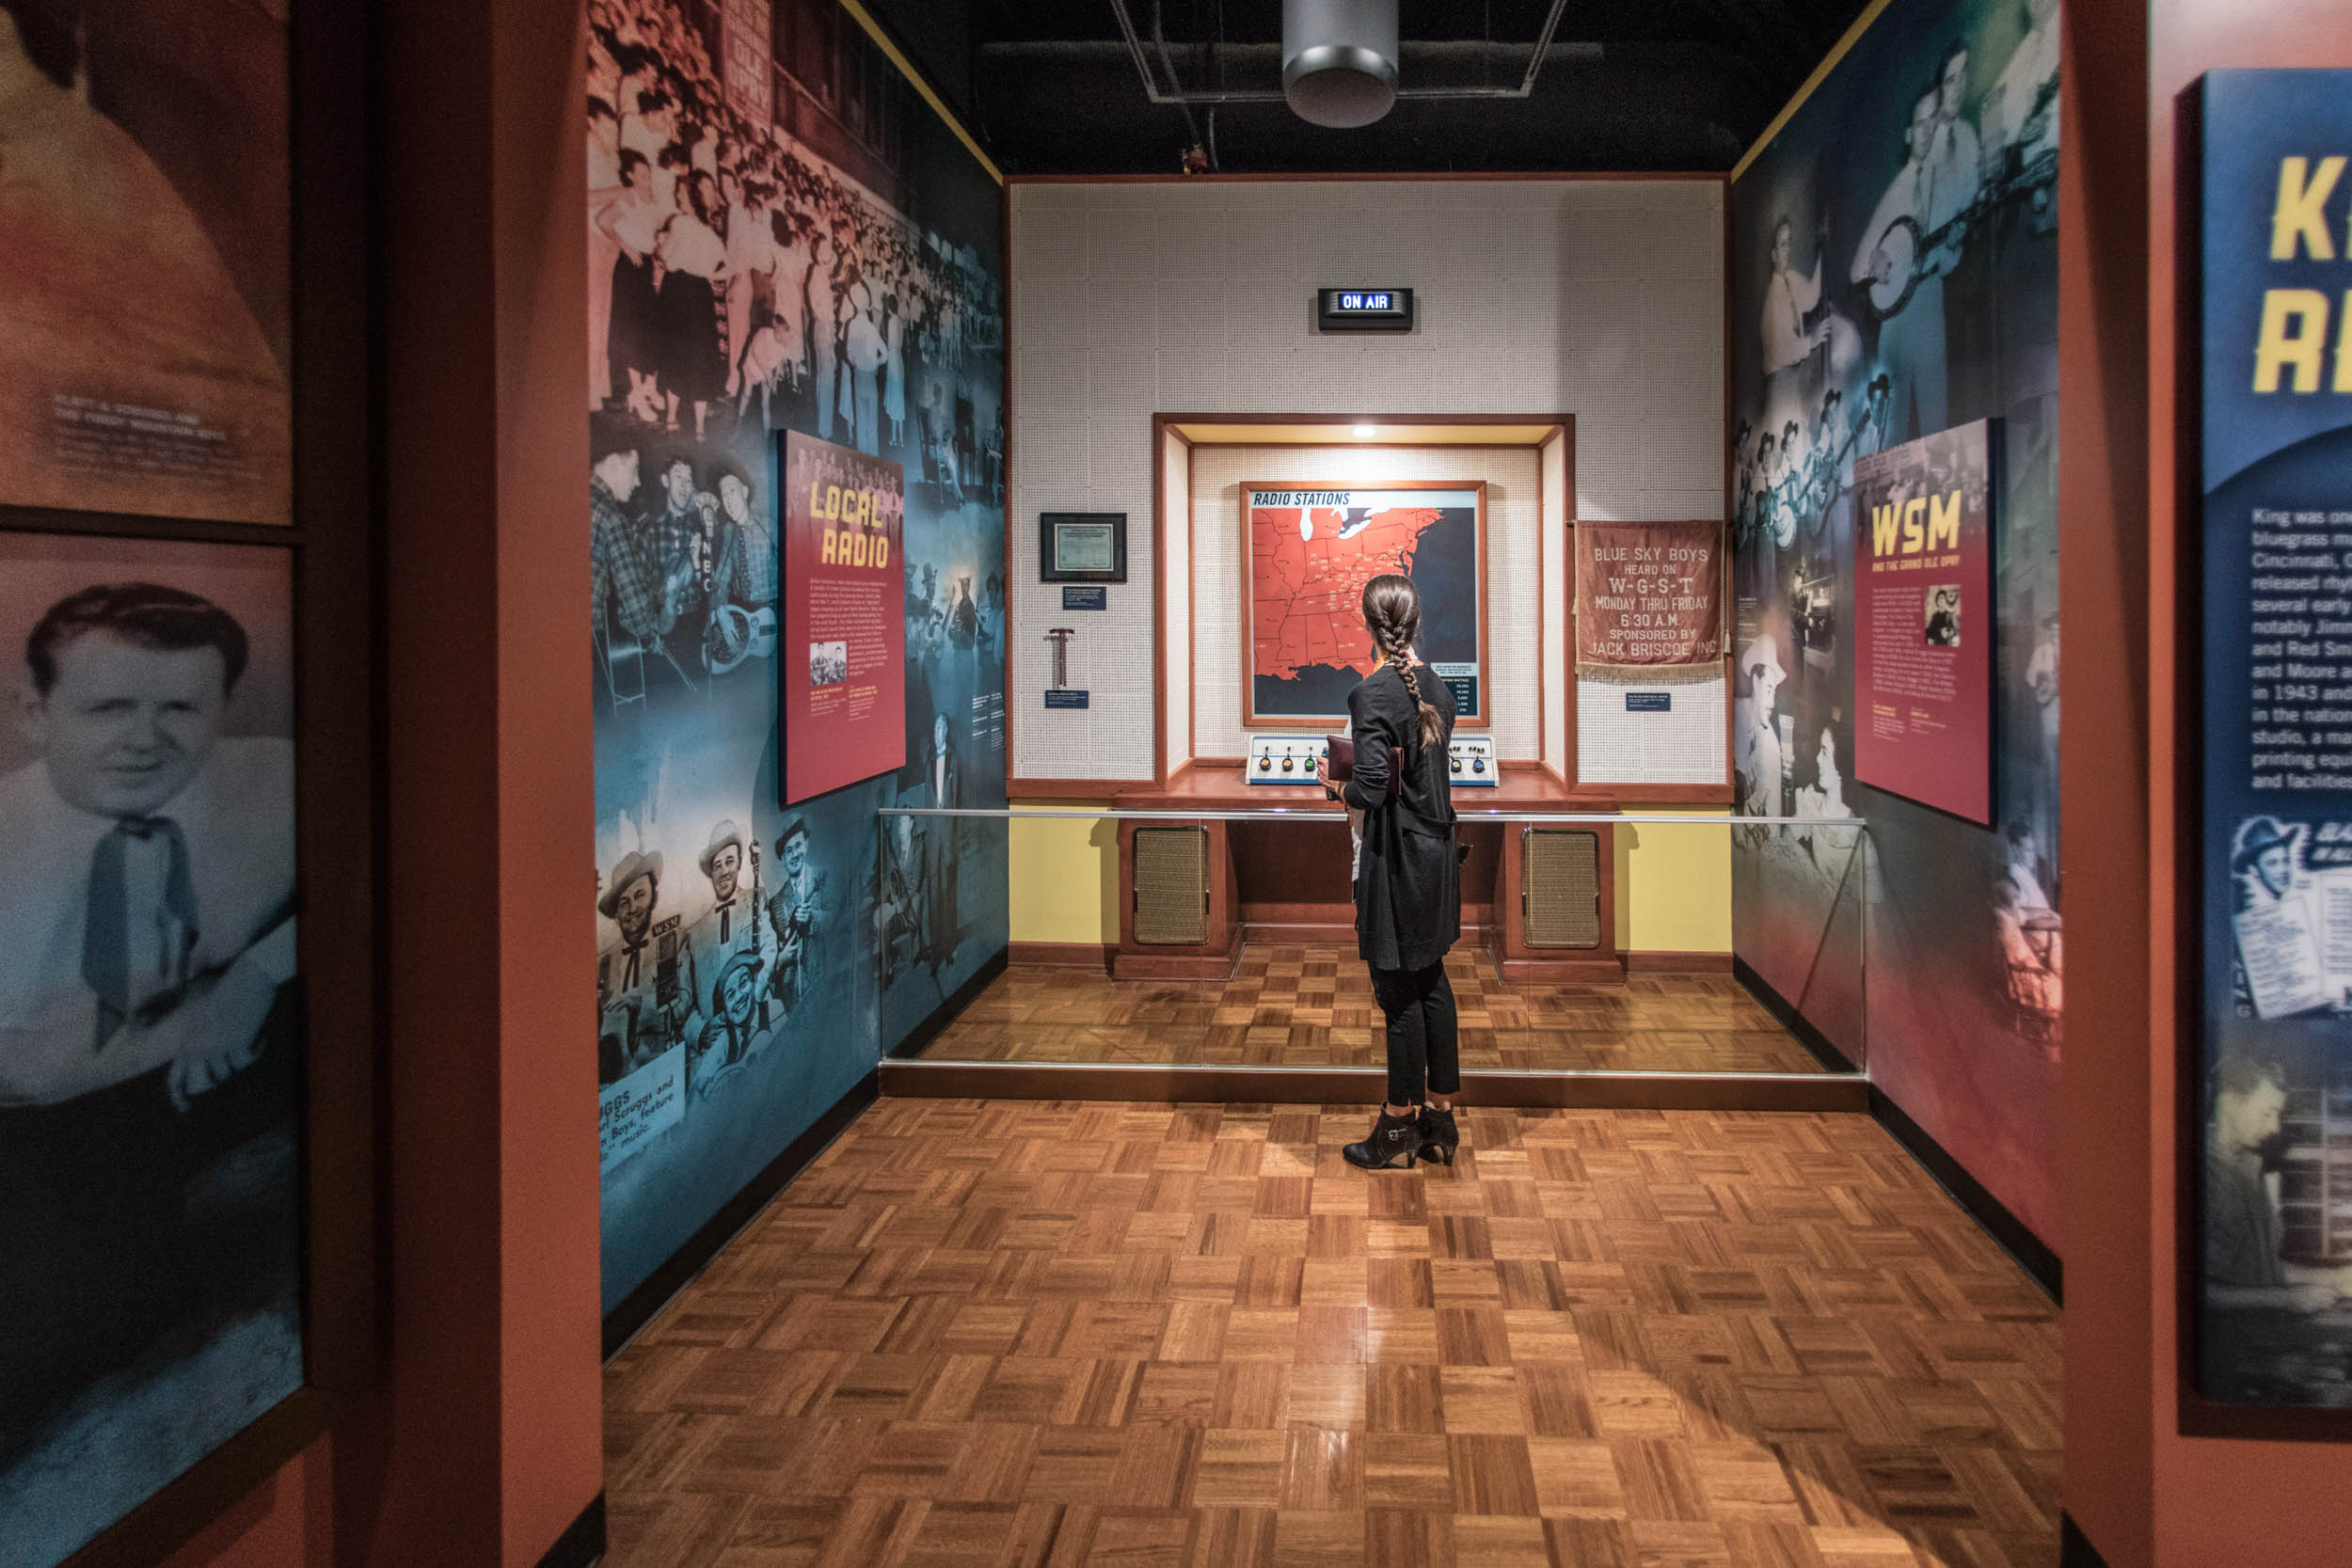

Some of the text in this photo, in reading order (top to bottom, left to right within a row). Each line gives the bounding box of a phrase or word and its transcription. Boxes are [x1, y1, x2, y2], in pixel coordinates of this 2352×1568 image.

[2269, 156, 2352, 261] K
[1343, 294, 1388, 309] ON AIR
[810, 482, 882, 528] LOCAL
[1253, 493, 1350, 505] RADIO STATIONS
[1872, 489, 1962, 557] WSM
[2251, 509, 2291, 527] King
[2295, 512, 2325, 524] was
[2251, 531, 2329, 548] bluegrass
[821, 528, 888, 569] RADIO
[1595, 547, 1708, 562] BLUE SKY BOYS
[2251, 552, 2340, 570] Cincinnati,
[1624, 564, 1677, 575] HEARD ON
[1609, 578, 1693, 594] W-G-S-T
[2251, 576, 2319, 590] released
[1595, 595, 1708, 610] MONDAY THRU FRIDAY
[2251, 598, 2351, 615] several early
[1610, 628, 1695, 640] SPONSORED BY
[2251, 620, 2312, 637] notably
[1588, 641, 1625, 656] JACK
[1630, 642, 1692, 656] BRISCOE
[2251, 641, 2282, 656] and
[2286, 641, 2319, 656] Red
[2251, 663, 2282, 678] and
[2286, 662, 2337, 678] Moore
[2251, 685, 2268, 700] in
[2274, 685, 2318, 700] 1943
[2251, 707, 2268, 721] in
[2272, 707, 2300, 721] the
[2312, 732, 2322, 744] a
[2251, 752, 2315, 769] printing
[2251, 773, 2282, 788] and
[614, 1093, 653, 1122] Scruggs
[657, 1074, 674, 1094] and
[641, 1094, 674, 1119] feature
